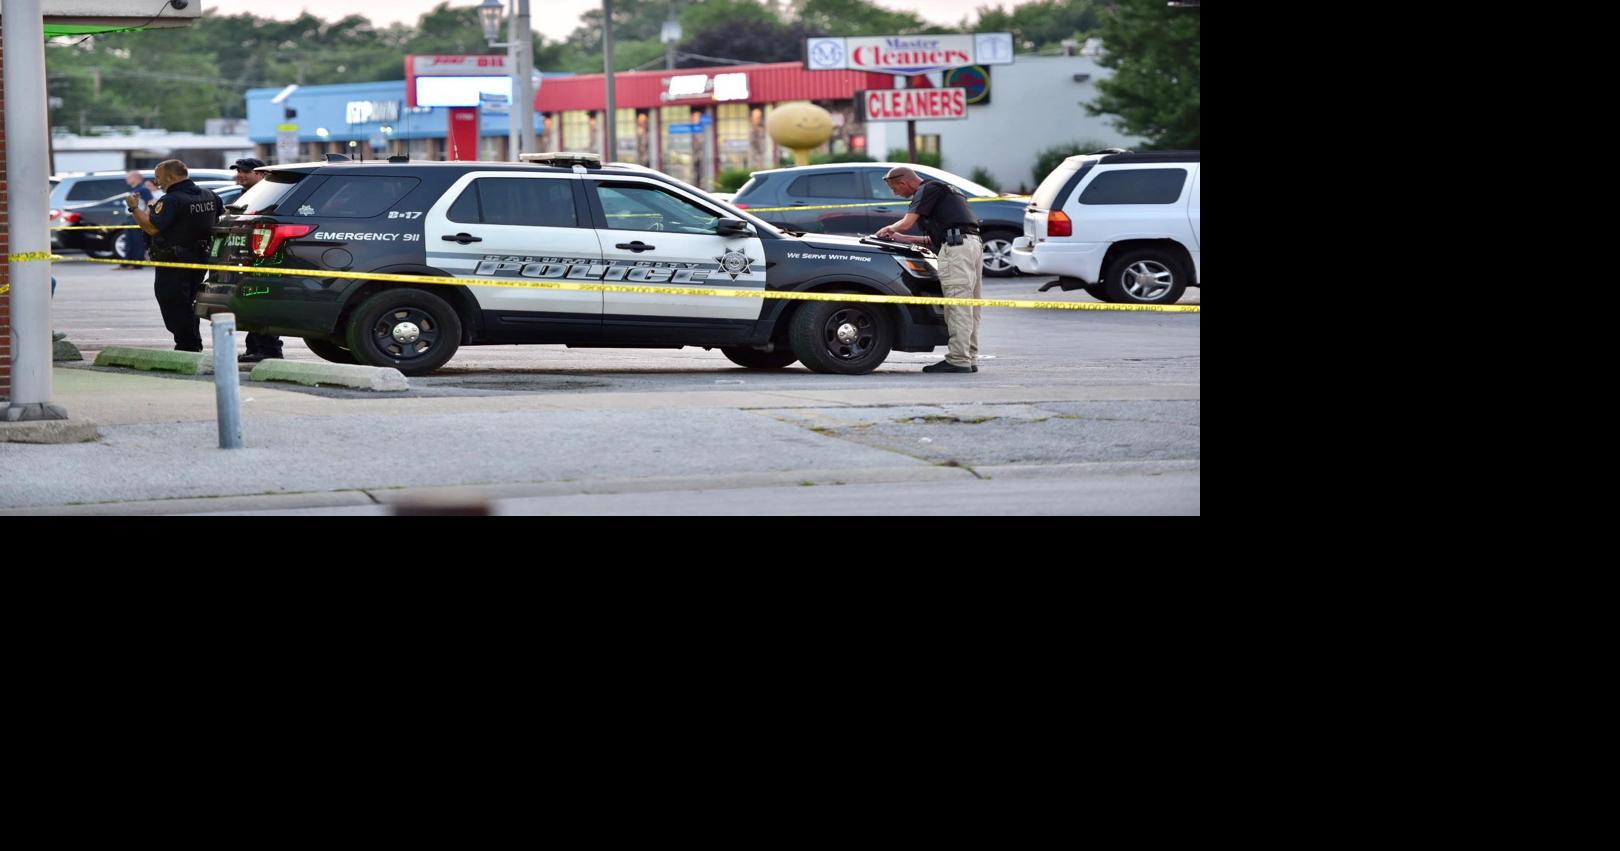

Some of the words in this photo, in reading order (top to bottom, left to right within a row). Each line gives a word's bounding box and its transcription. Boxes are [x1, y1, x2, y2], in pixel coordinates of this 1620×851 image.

[886, 37, 940, 49] Master
[853, 45, 970, 66] Cleaners
[868, 91, 965, 118] CLEANERS
[190, 201, 215, 214] POLICE
[387, 211, 422, 219] B-17
[314, 231, 400, 241] EMERGENCY
[402, 233, 420, 242] 911
[474, 260, 712, 285] POLICE
